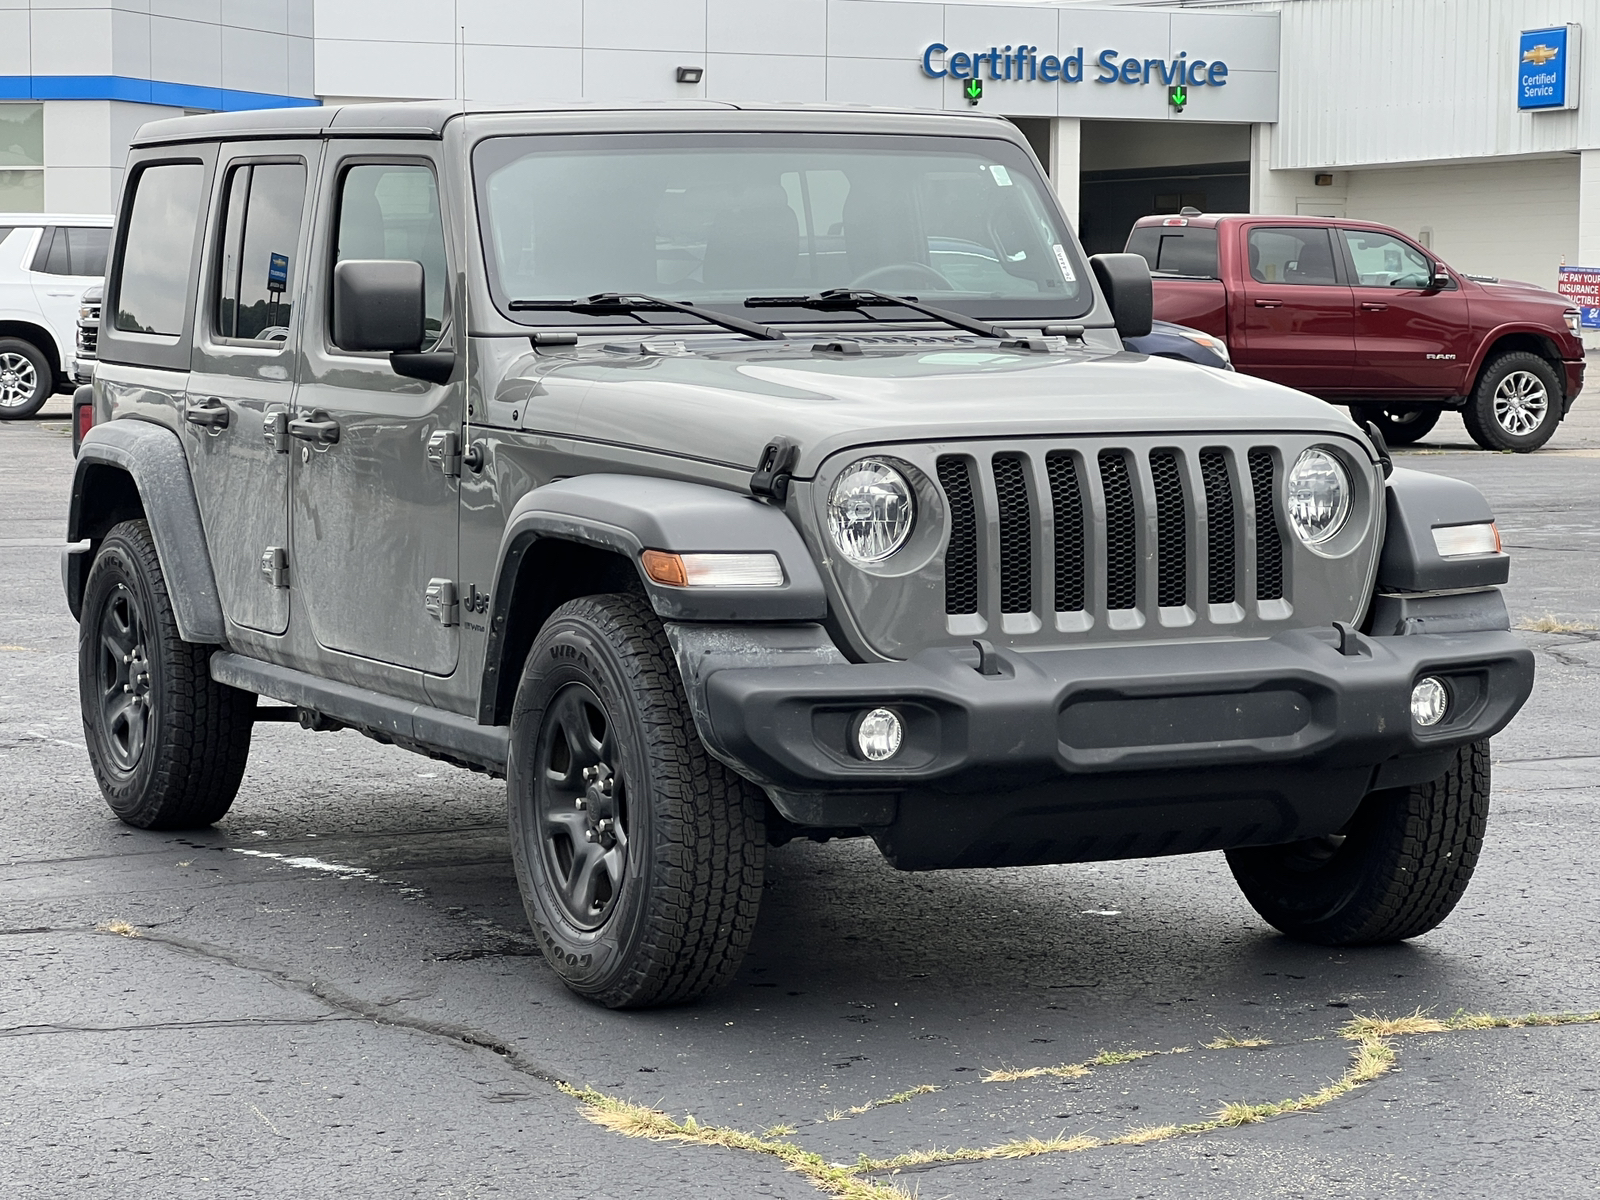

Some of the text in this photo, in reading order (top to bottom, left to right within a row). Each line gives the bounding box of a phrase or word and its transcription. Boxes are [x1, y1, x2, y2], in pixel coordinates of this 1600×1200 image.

[922, 43, 1228, 87] Certified Service
[1522, 72, 1556, 86] Certified
[1524, 85, 1553, 97] Service
[1558, 273, 1568, 282] WE
[1570, 273, 1582, 283] PAY
[1560, 284, 1599, 294] INSURANCE
[1562, 294, 1600, 305] UCTIBLE
[464, 583, 491, 614] Jee
